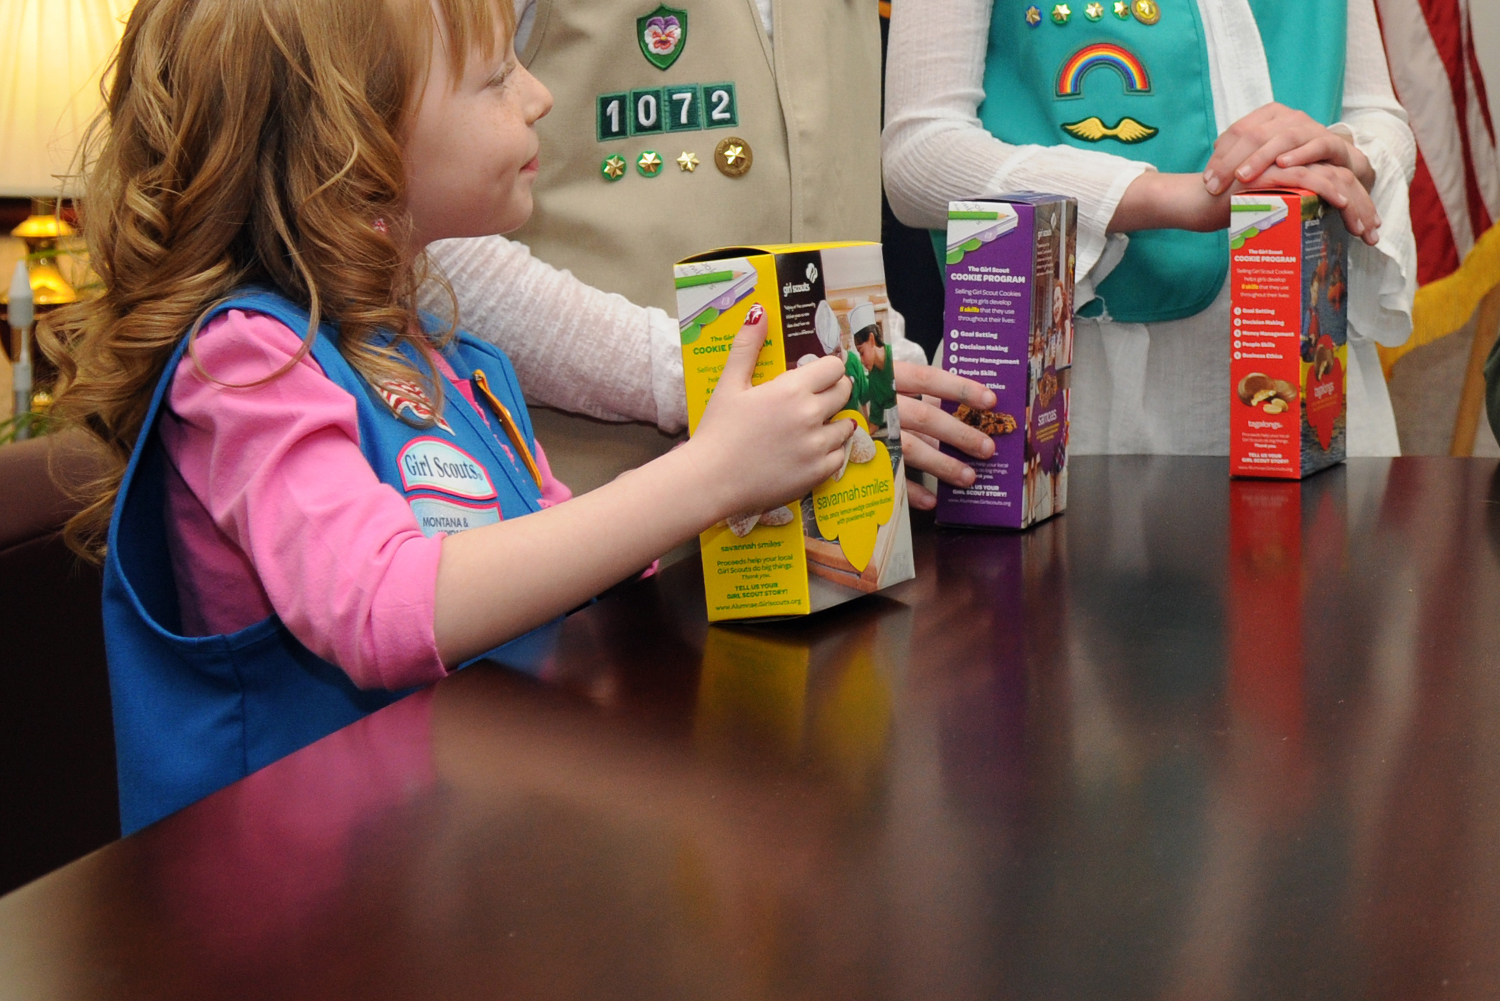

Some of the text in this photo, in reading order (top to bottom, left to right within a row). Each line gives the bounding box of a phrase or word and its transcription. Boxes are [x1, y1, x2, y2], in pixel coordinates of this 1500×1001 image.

[606, 90, 731, 133] 1072
[951, 273, 1025, 283] COOKIE PROGRAM
[783, 282, 810, 297] girl scouts
[955, 288, 972, 296] Selling
[693, 344, 726, 355] COOKIE
[986, 345, 1008, 353] Making
[980, 357, 1020, 365] Management
[1038, 409, 1057, 426] samoas
[405, 454, 434, 478] Girl
[817, 478, 889, 510] savannah smiles
[422, 517, 469, 527] MONTANA &
[721, 541, 782, 551] savannah smiles
